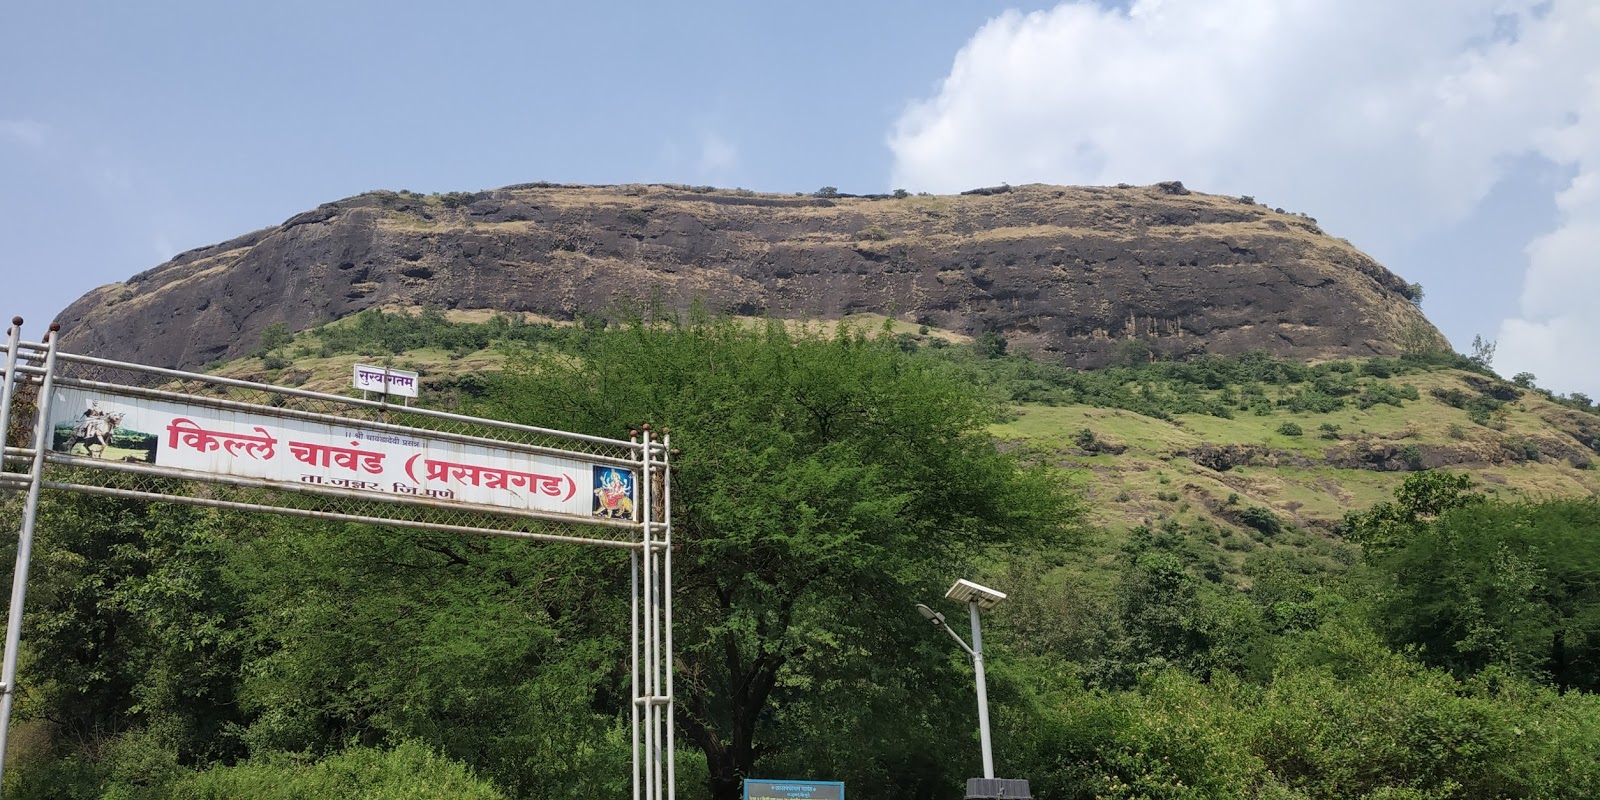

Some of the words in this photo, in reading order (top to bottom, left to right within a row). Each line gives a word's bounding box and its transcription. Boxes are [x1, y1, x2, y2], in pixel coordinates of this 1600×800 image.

[166, 417, 278, 461] किल्ले
[288, 440, 386, 475] चावंड
[404, 453, 577, 503] (प्रसन्नगड)
